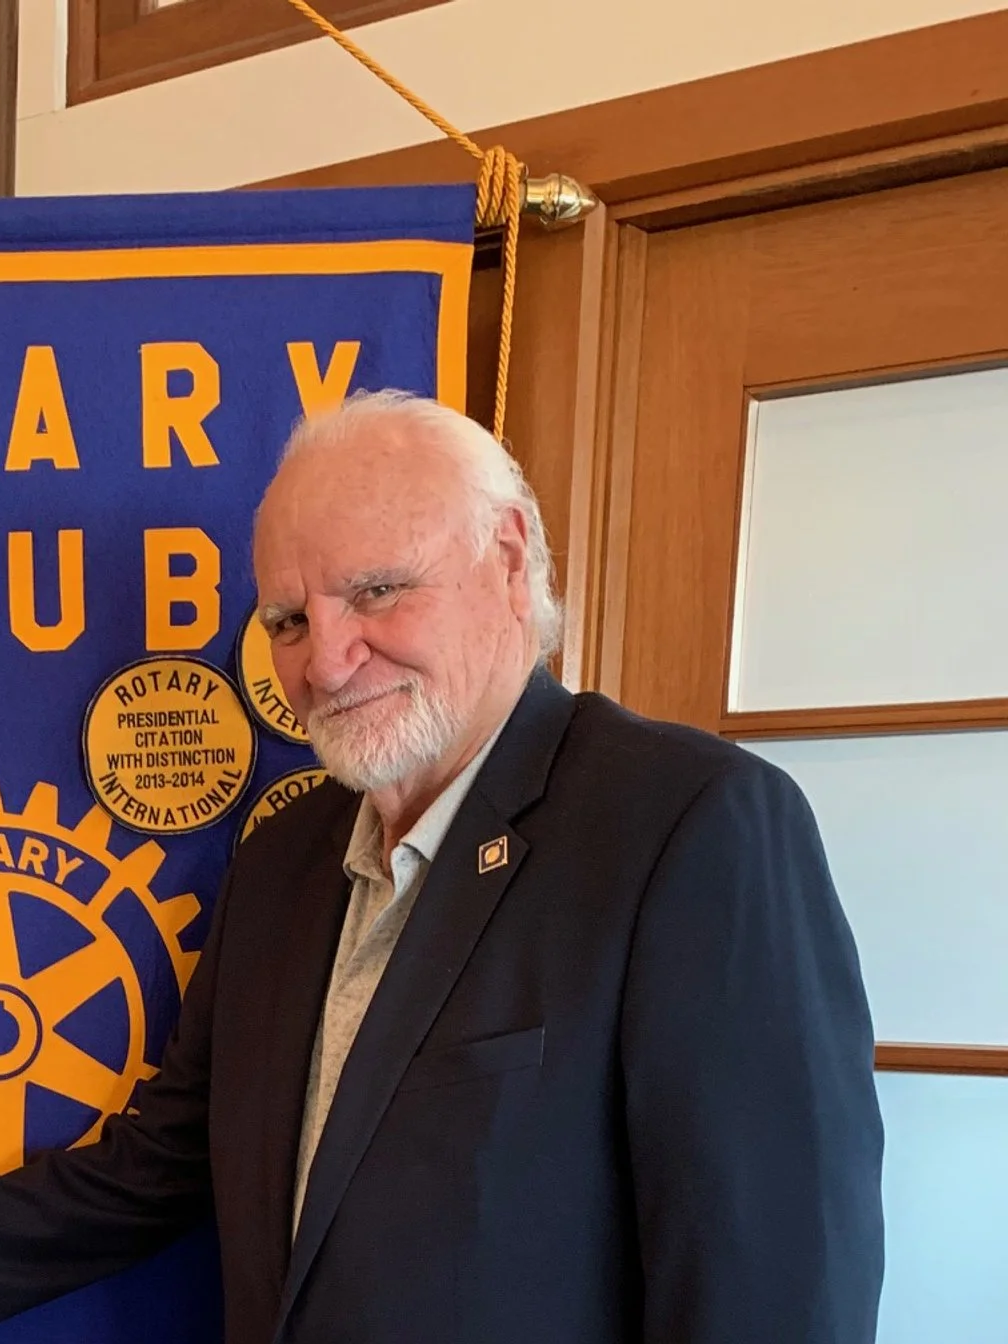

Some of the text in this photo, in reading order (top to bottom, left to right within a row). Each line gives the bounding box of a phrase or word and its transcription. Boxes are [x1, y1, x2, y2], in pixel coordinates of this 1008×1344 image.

[114, 670, 219, 707] ROTARY
[118, 709, 219, 729] PRESIDENTIAL
[135, 730, 203, 748] CITATION
[107, 748, 235, 770] WITH DISTINCTION
[135, 772, 204, 789] 2013-2014
[99, 769, 242, 826] INTERNATIONAL
